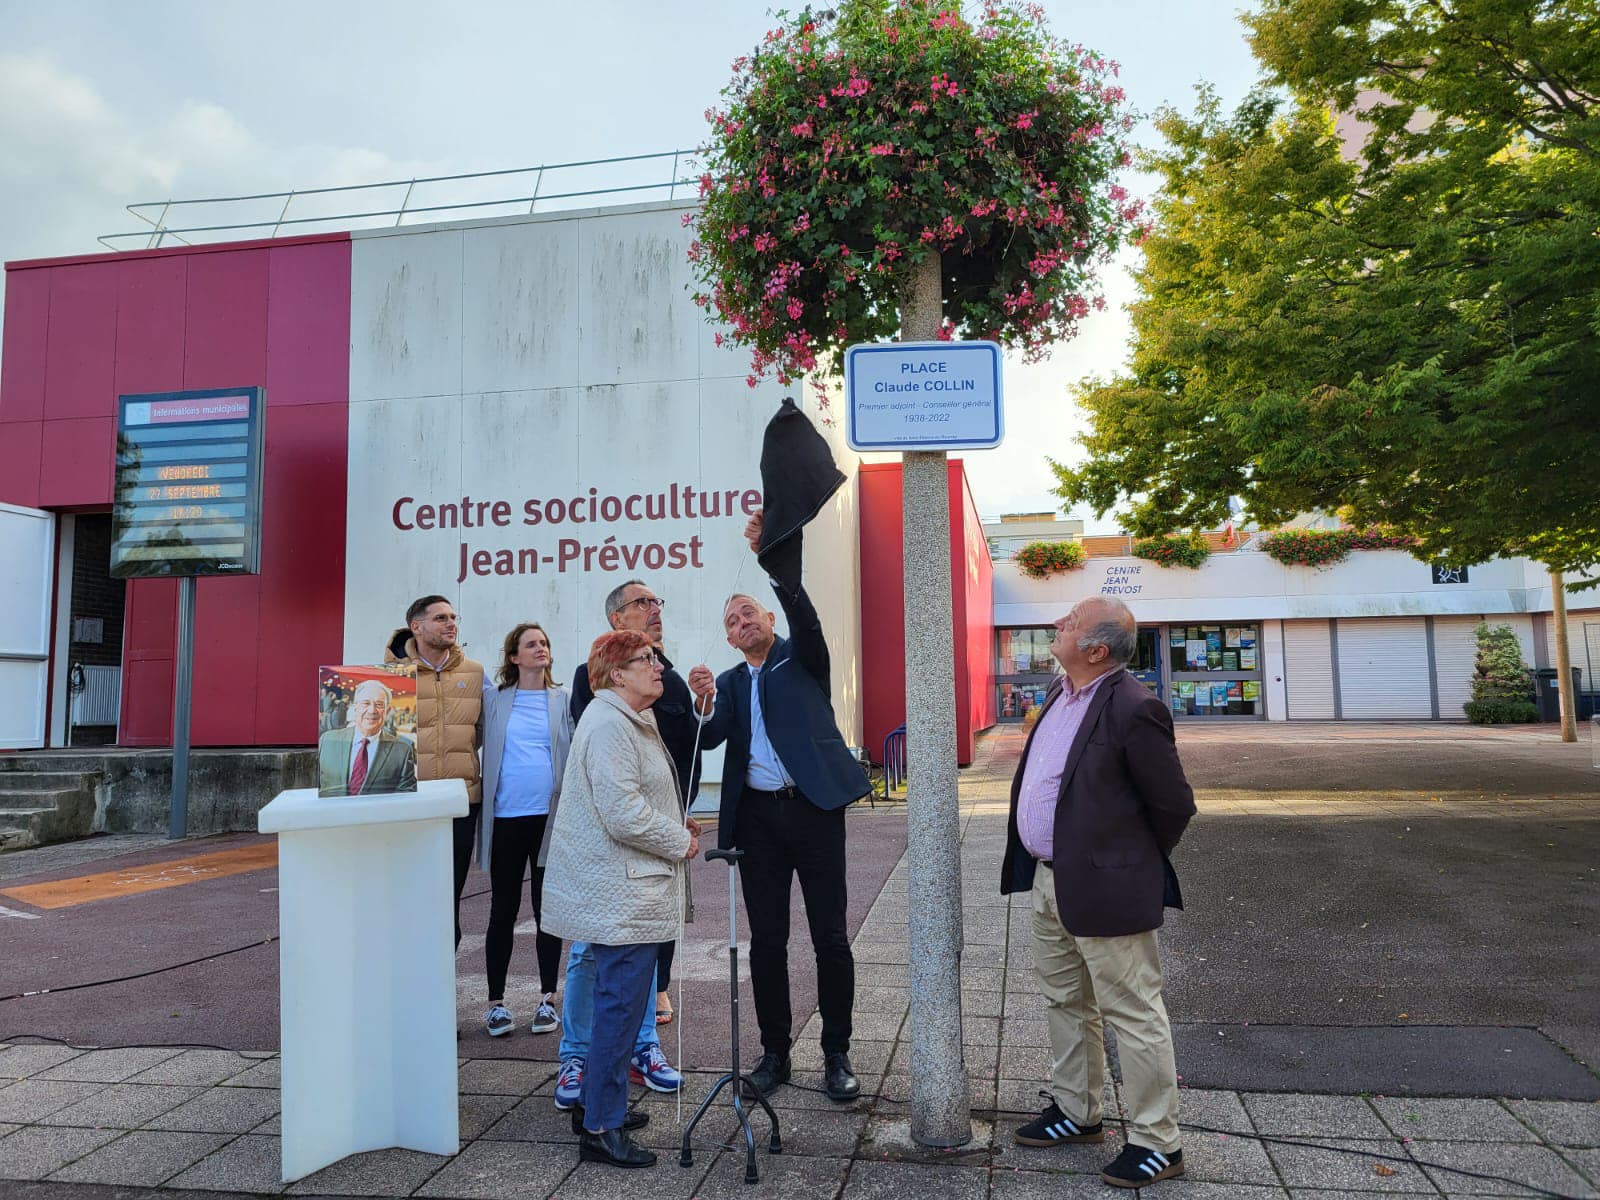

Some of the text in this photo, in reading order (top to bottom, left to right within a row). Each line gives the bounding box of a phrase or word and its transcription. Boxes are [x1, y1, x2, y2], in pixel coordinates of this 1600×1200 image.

[901, 362, 947, 374] PLACE
[874, 380, 975, 393] Claude COLLIN
[858, 402, 889, 411] Premier
[890, 401, 916, 410] adjoint
[922, 400, 961, 409] Conseiller
[153, 407, 200, 417] Informations
[904, 413, 950, 423] 1938-2022
[160, 465, 209, 480] VENDREDI
[167, 484, 221, 499] SEPTEMBRE
[392, 496, 511, 531] Centre
[457, 535, 704, 583] Jean-Prévost
[1106, 566, 1142, 575] CENTRE
[1103, 576, 1129, 585] JEAN
[1101, 585, 1143, 594] PREVOST
